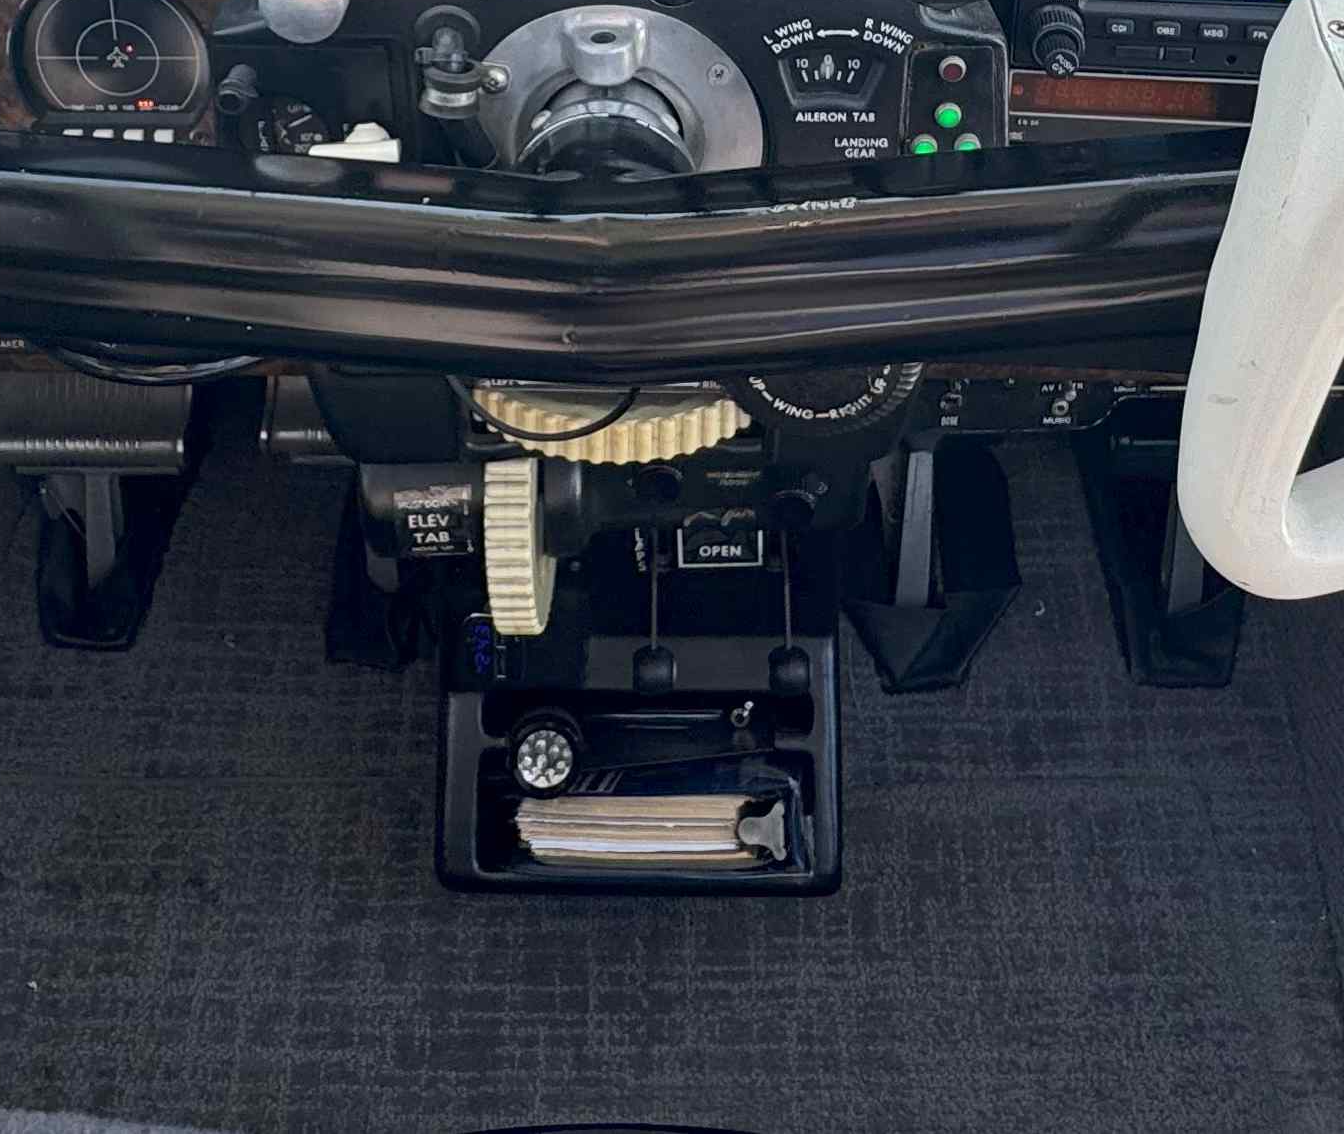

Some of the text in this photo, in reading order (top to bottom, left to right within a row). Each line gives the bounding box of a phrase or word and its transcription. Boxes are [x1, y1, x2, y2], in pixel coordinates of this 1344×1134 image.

[763, 18, 813, 45] L WING
[864, 18, 914, 45] R WING
[771, 30, 814, 54] DOWN
[862, 30, 906, 54] DOWN
[796, 54, 860, 69] 10 0 10
[795, 112, 875, 122] AILERON TAB
[834, 138, 889, 148] LANDING
[845, 148, 876, 158] GEAR
[773, 398, 815, 419] WING
[407, 513, 450, 530] ELEV
[413, 531, 451, 544] TAB
[698, 543, 743, 558] OPEN
